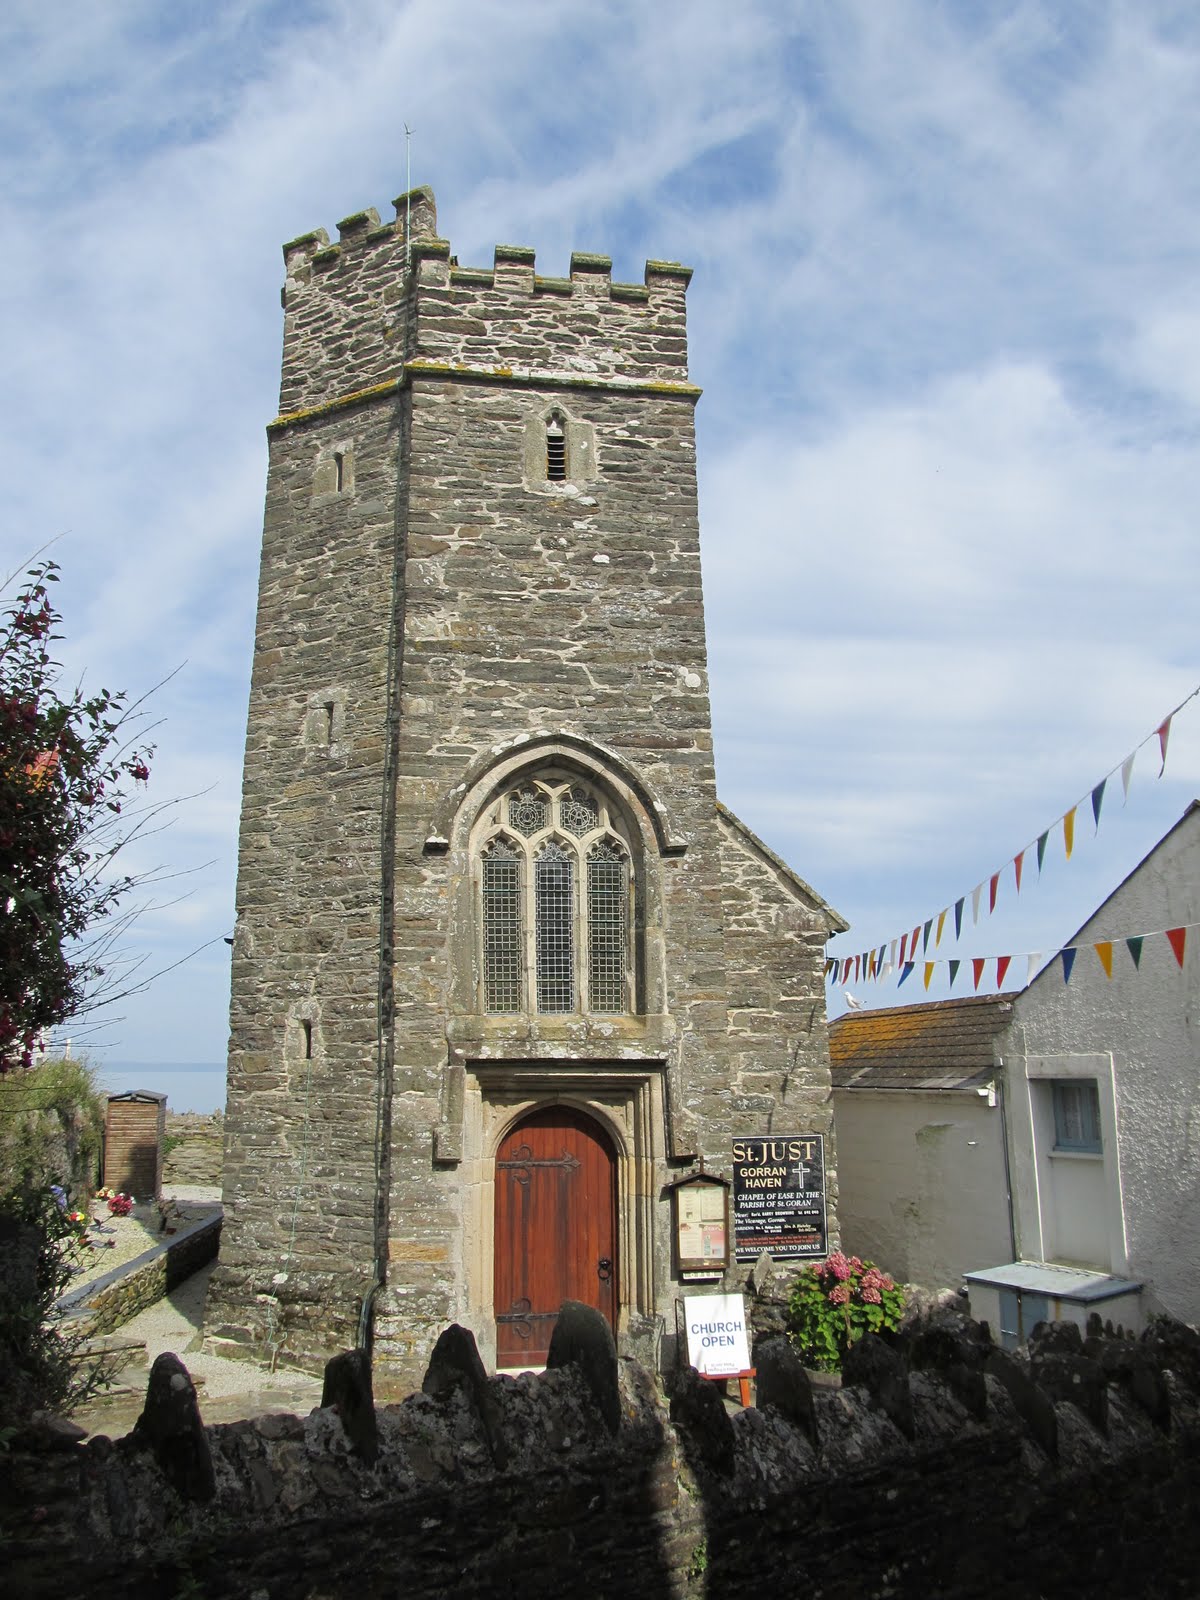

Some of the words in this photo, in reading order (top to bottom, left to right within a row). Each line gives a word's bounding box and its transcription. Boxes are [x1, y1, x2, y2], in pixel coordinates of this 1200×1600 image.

[740, 1167, 787, 1177] GORRAN
[745, 1178, 782, 1188] HAVEN
[738, 1193, 765, 1201] CHAPEL
[777, 1192, 795, 1200] EASE
[805, 1191, 820, 1199] THE
[740, 1201, 765, 1209] PARISH
[766, 1200, 776, 1208] OF
[744, 1245, 775, 1253] WELCOME
[775, 1244, 788, 1252] YOU
[797, 1244, 811, 1252] JOIN
[691, 1321, 742, 1335] CHURCH
[701, 1335, 735, 1348] OPEN
